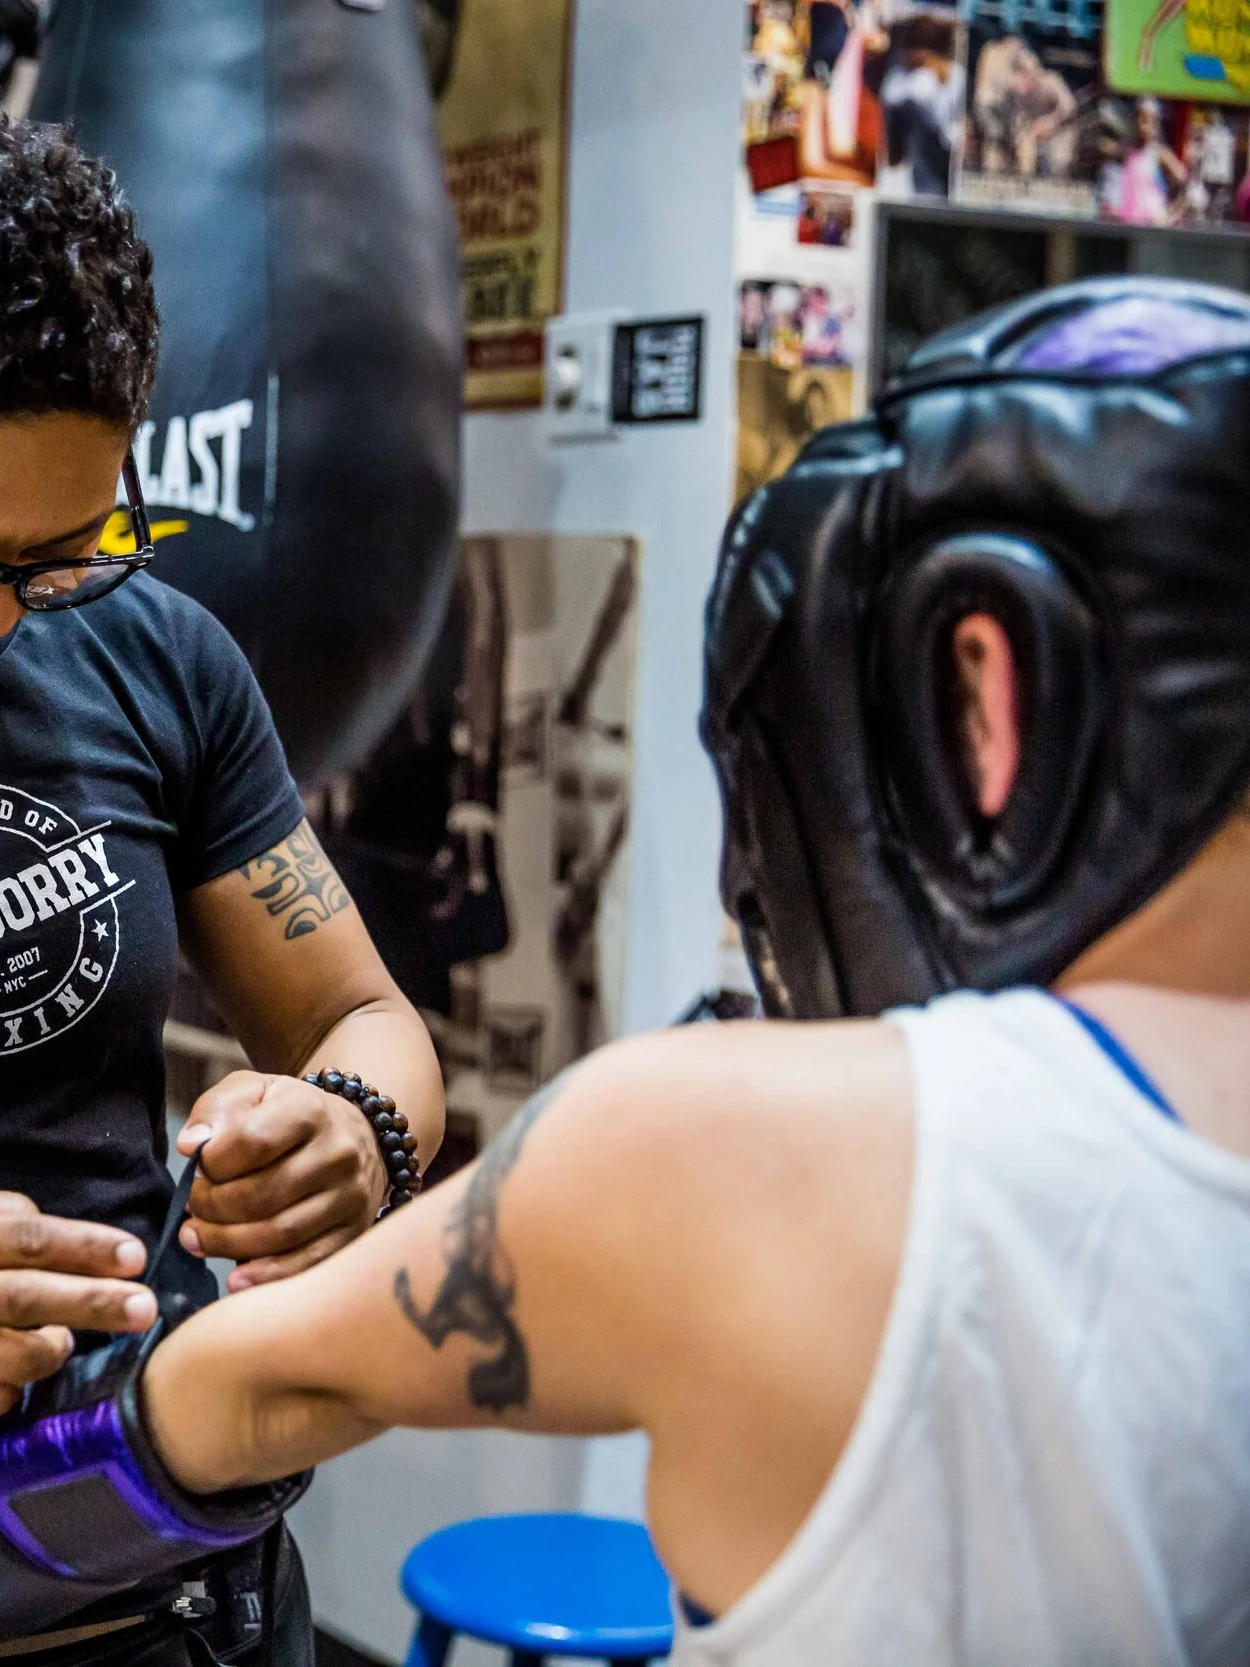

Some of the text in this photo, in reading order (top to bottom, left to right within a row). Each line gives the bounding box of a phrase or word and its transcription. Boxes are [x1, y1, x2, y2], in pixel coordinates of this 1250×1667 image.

[116, 398, 254, 530] LAST
[25, 810, 57, 835] OF
[7, 947, 41, 972] 2007
[4, 976, 27, 994] NYC
